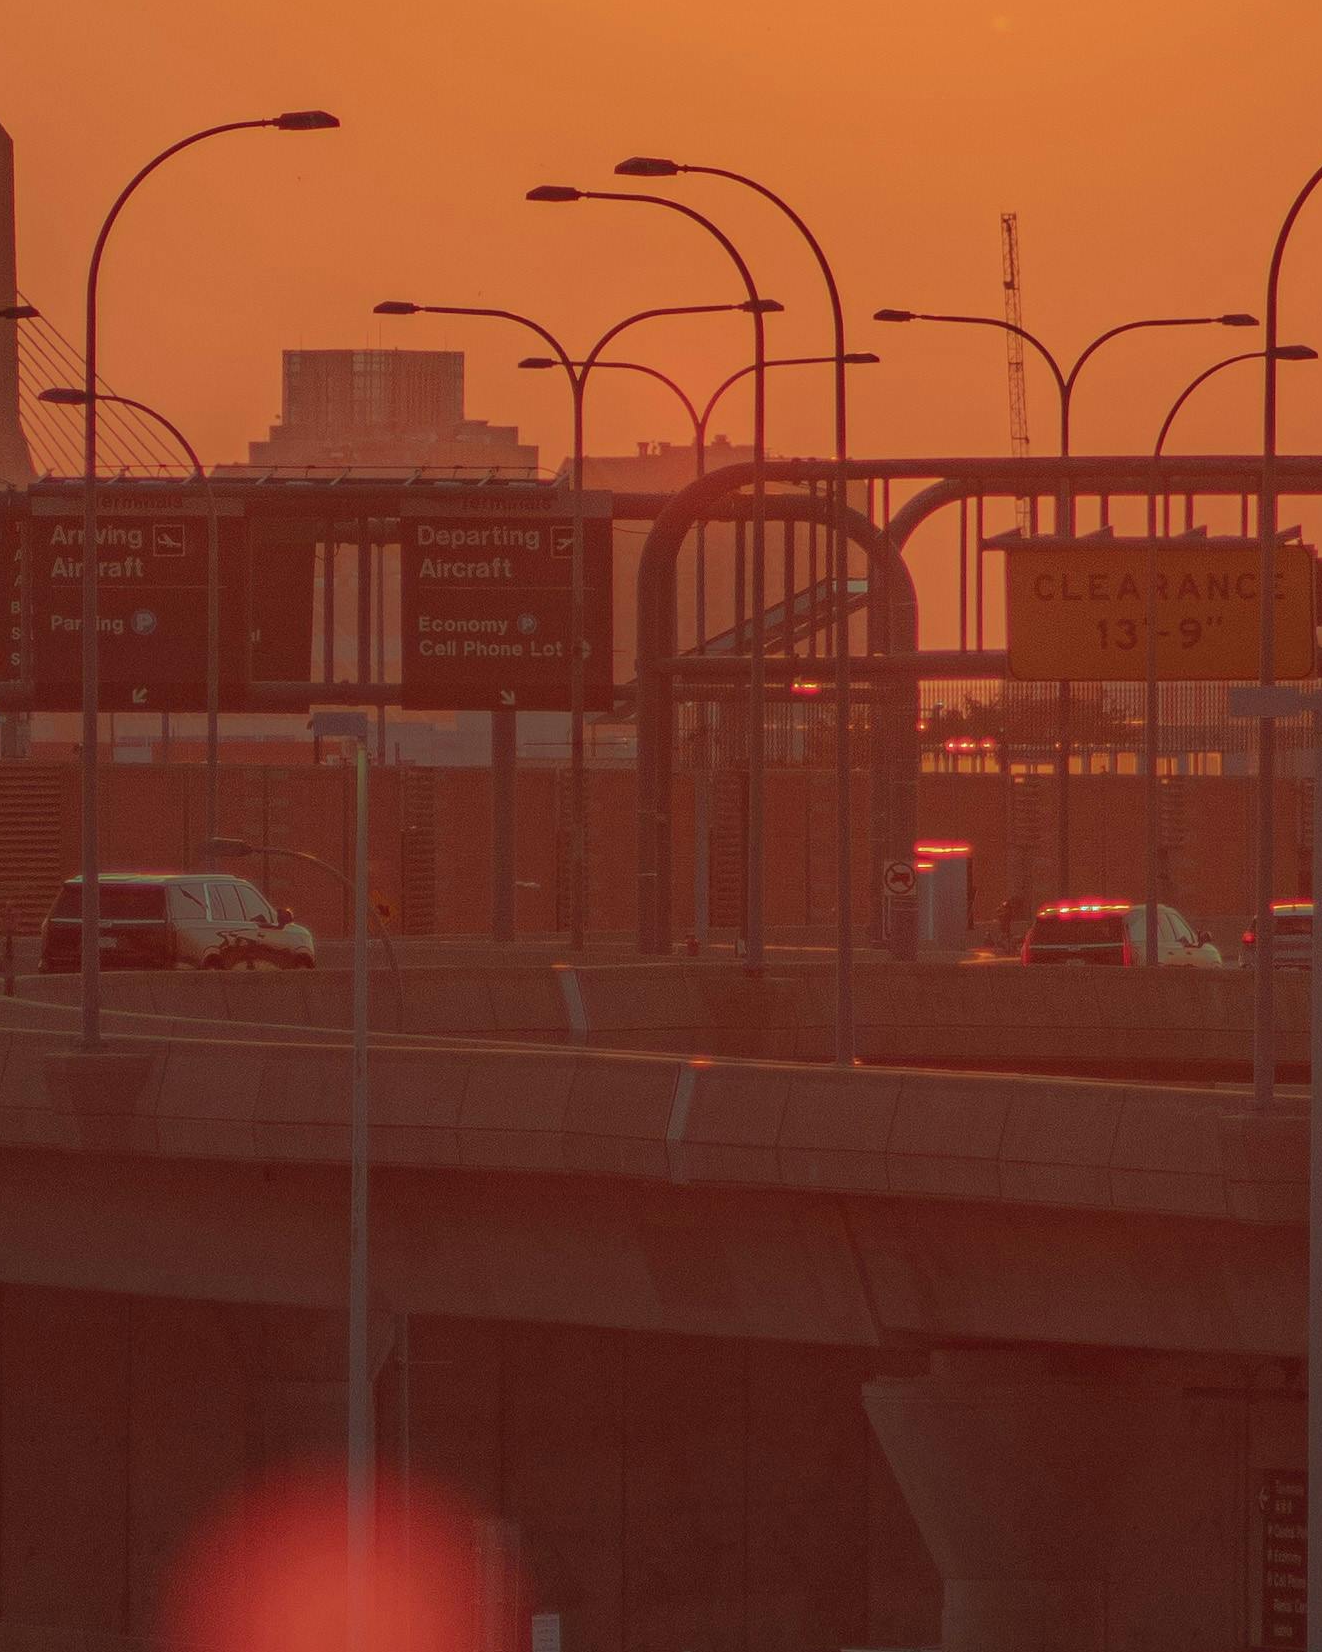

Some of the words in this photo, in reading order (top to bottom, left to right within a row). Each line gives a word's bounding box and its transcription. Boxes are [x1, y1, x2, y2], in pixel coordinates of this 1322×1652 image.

[418, 525, 539, 550] Departing
[51, 557, 144, 578] Airraft
[419, 558, 512, 578] Aircraft
[51, 615, 124, 634] Paring
[419, 616, 508, 636] Economy
[419, 640, 457, 657] Cell
[463, 640, 523, 657] Phone
[530, 640, 563, 657] Lot
